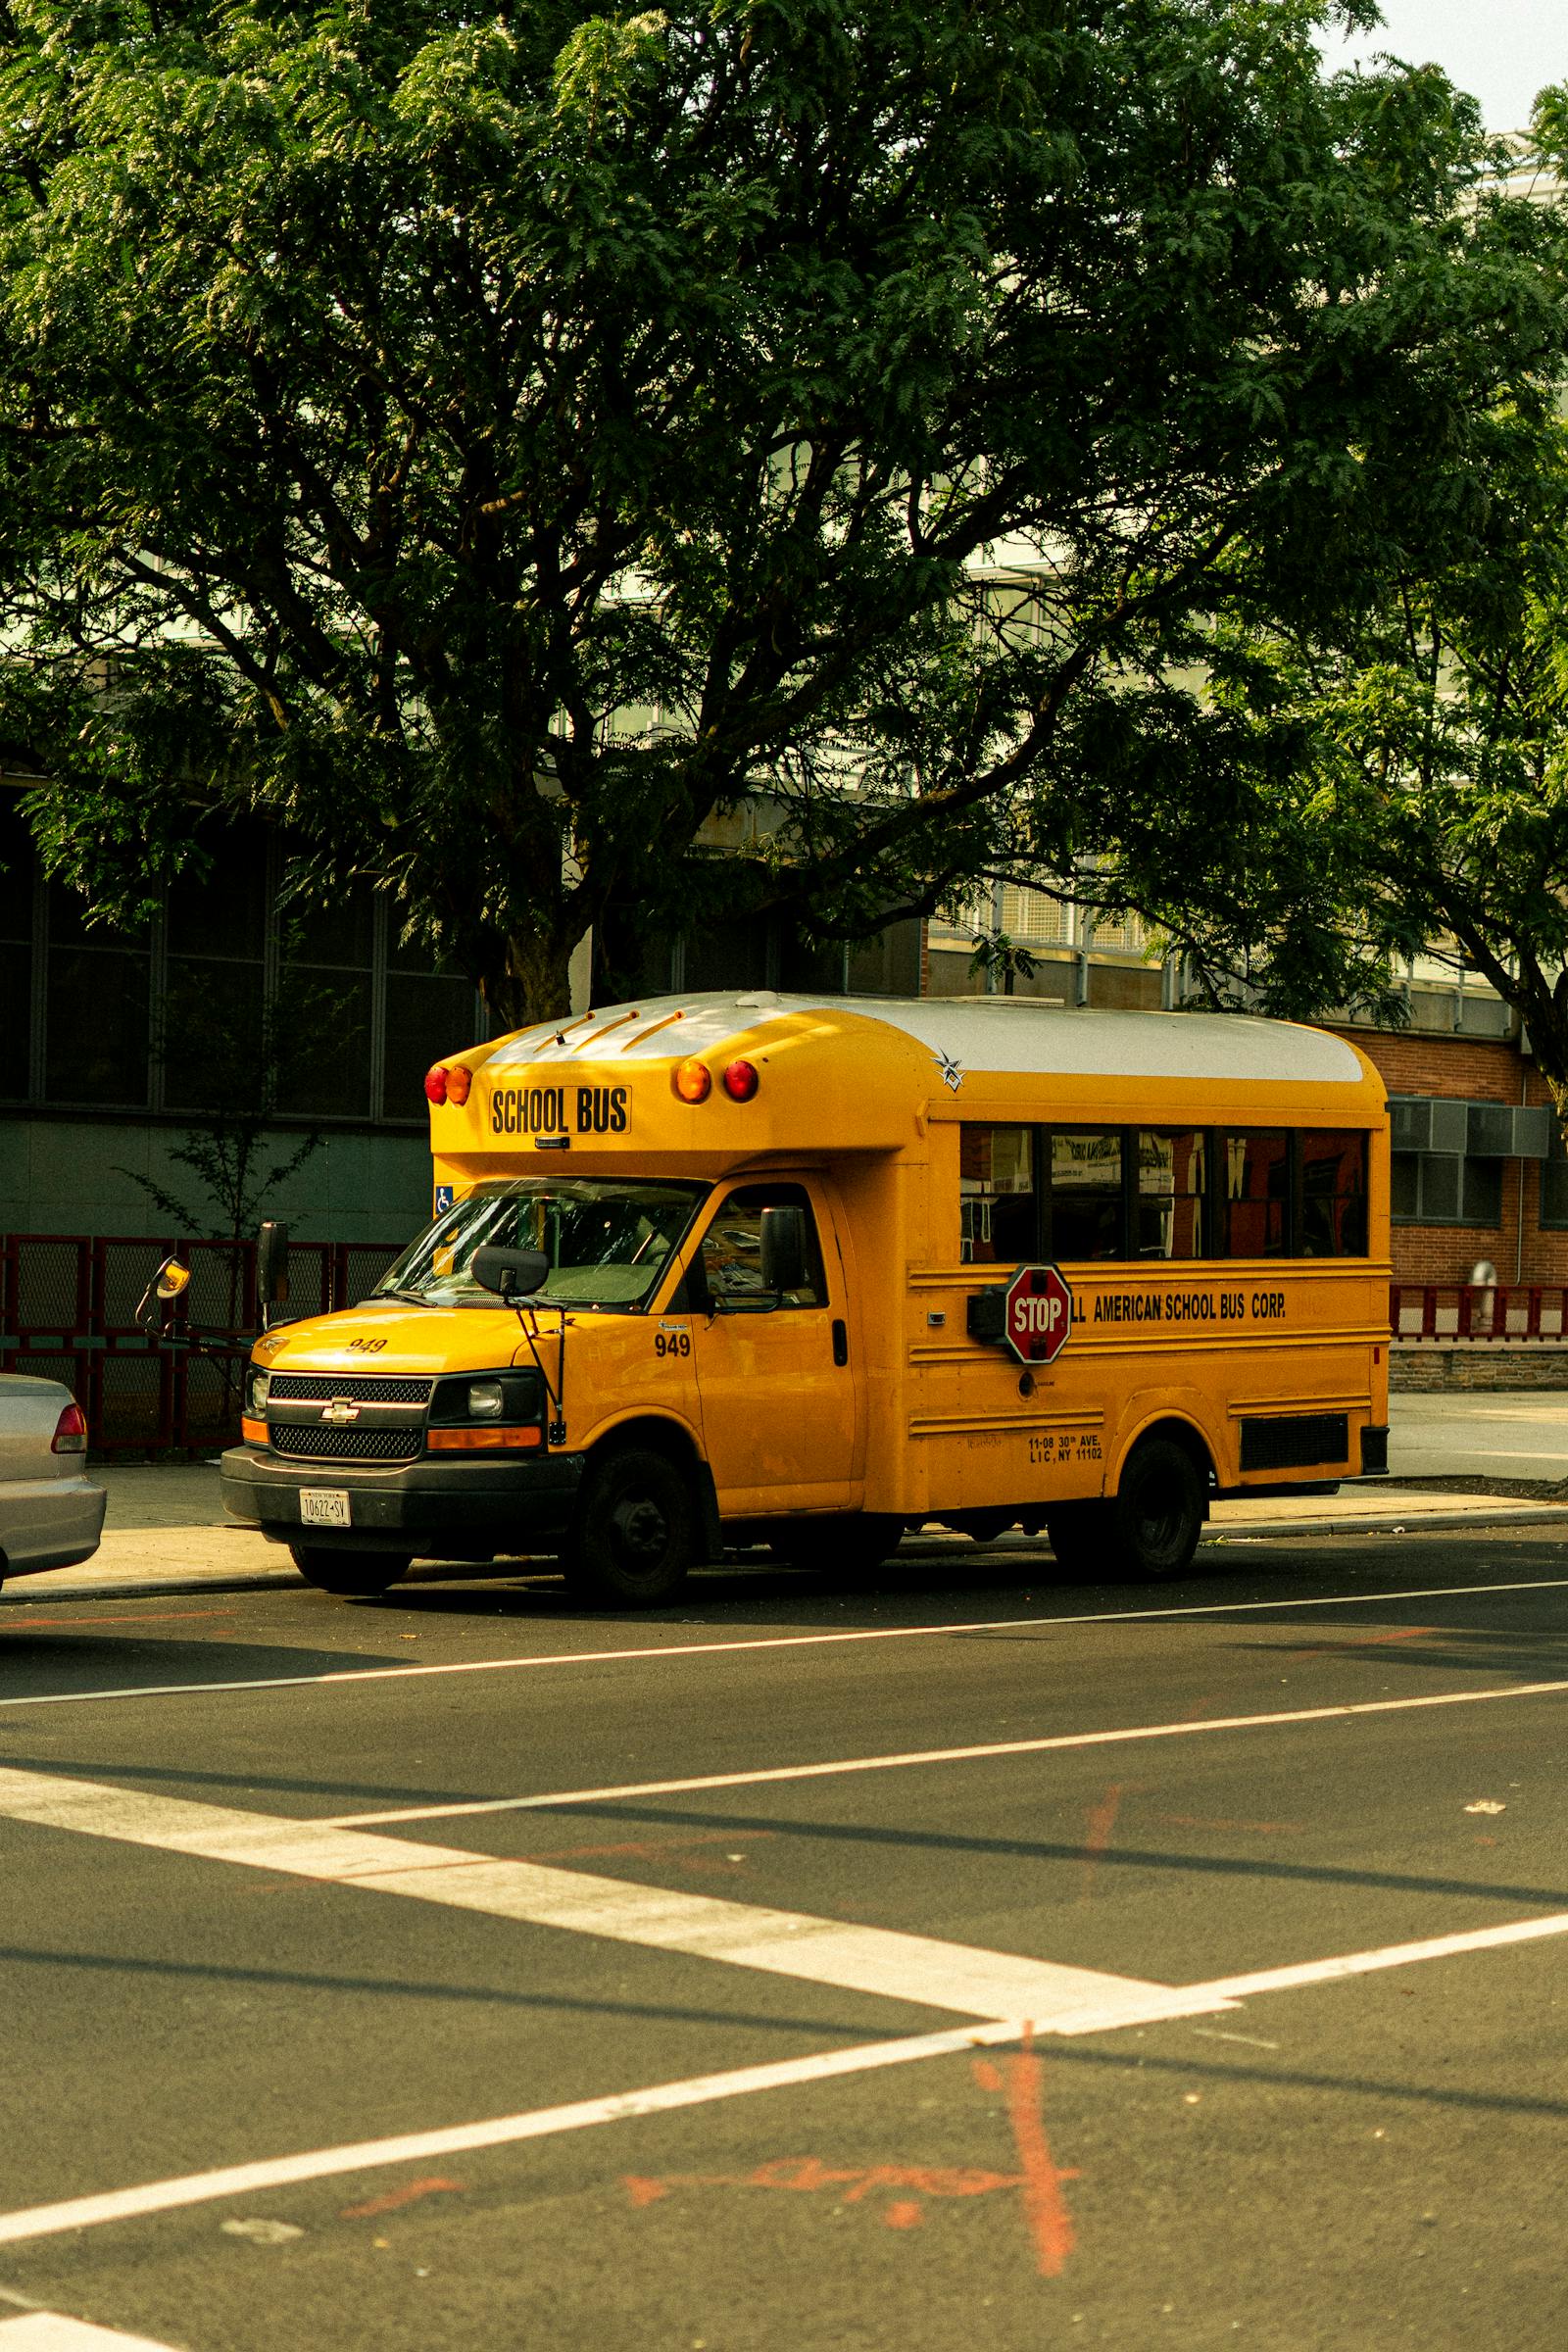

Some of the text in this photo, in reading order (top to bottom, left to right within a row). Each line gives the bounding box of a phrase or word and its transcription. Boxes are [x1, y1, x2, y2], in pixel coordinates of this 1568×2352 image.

[493, 1087, 626, 1133] SCHOOL BUS
[1014, 1298, 1061, 1332] STOP
[1071, 1293, 1286, 1322] LL AMERICAN SCHOOL BUS CORP.
[345, 1339, 388, 1353] 949
[655, 1333, 691, 1357] 949
[1029, 1437, 1054, 1449] 11-08
[1080, 1435, 1101, 1446] AVE.
[1076, 1447, 1102, 1460] 11102
